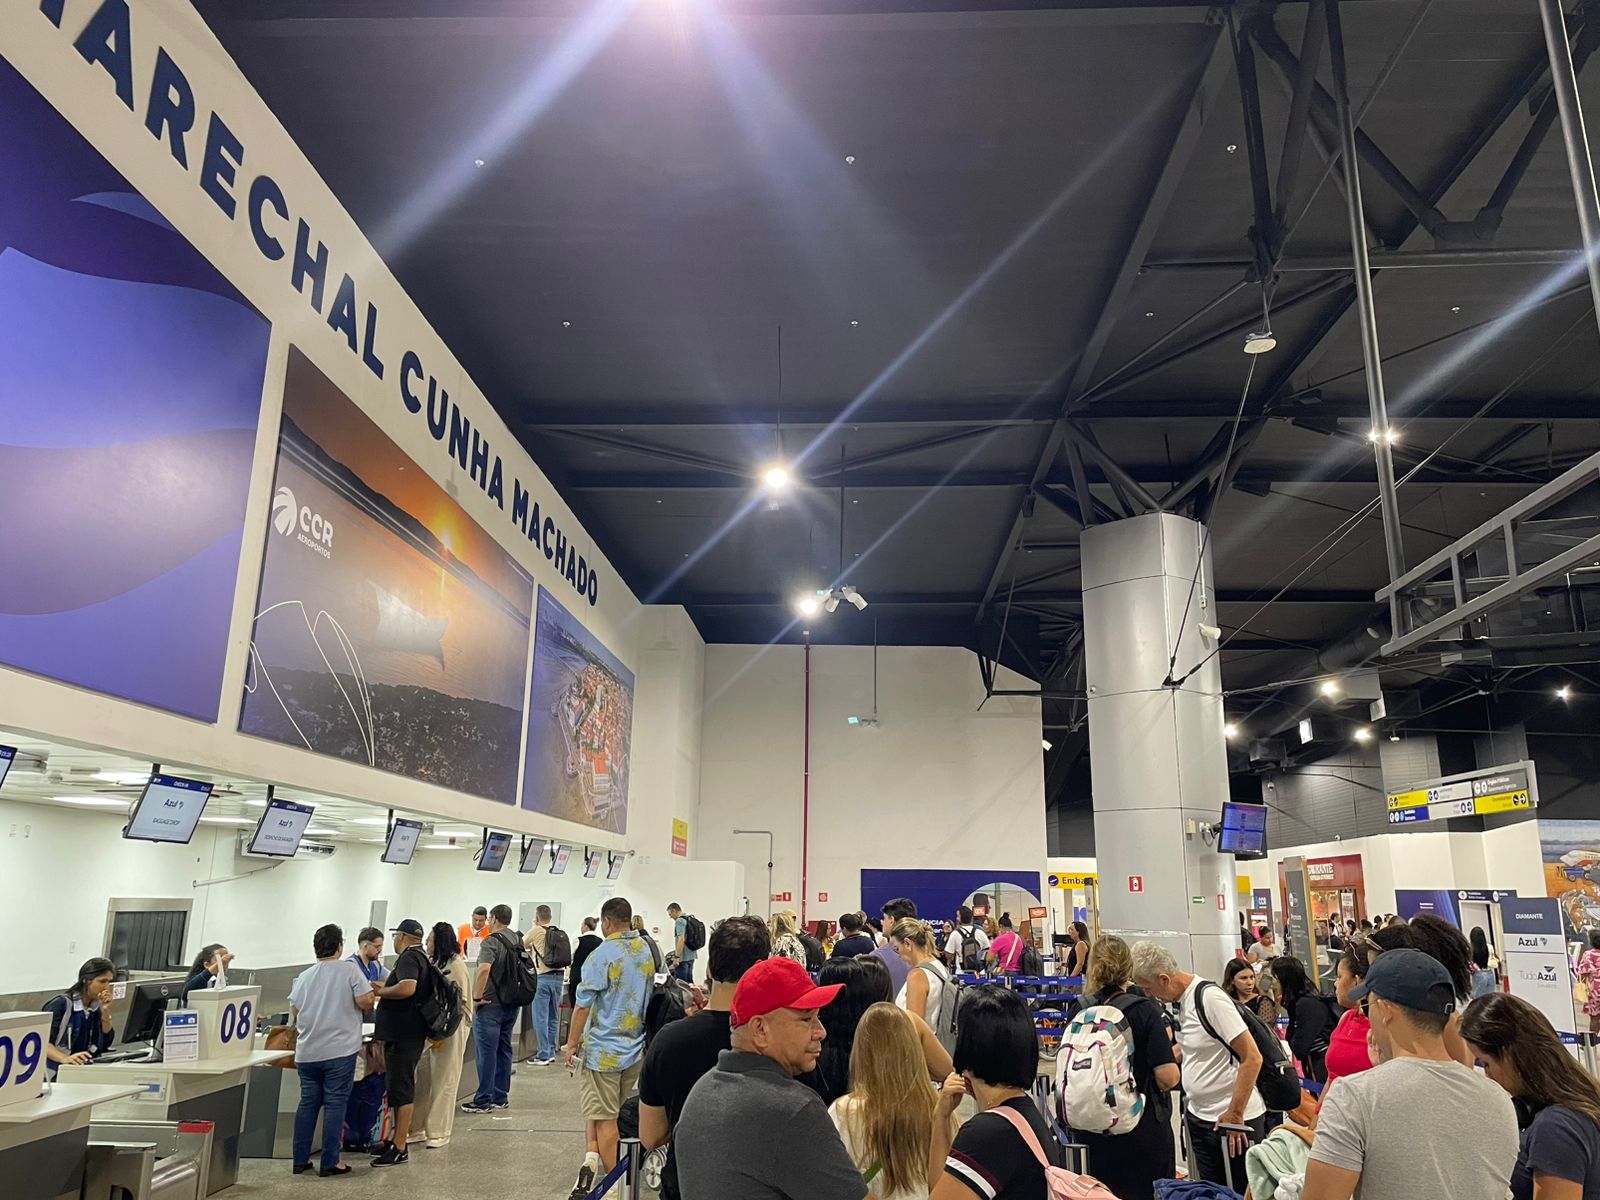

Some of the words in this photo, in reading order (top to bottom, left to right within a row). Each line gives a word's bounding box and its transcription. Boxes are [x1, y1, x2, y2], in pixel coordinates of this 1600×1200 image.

[39, 0, 384, 379] ARECHAL
[400, 351, 503, 510] CUNHA
[512, 478, 598, 606] MACHADO
[300, 505, 334, 548] CCR
[297, 532, 331, 559] AEROPORTOS
[164, 799, 178, 808] Azul
[1062, 876, 1086, 886] Emba
[1518, 936, 1538, 947] Azul
[220, 1000, 252, 1044] 08
